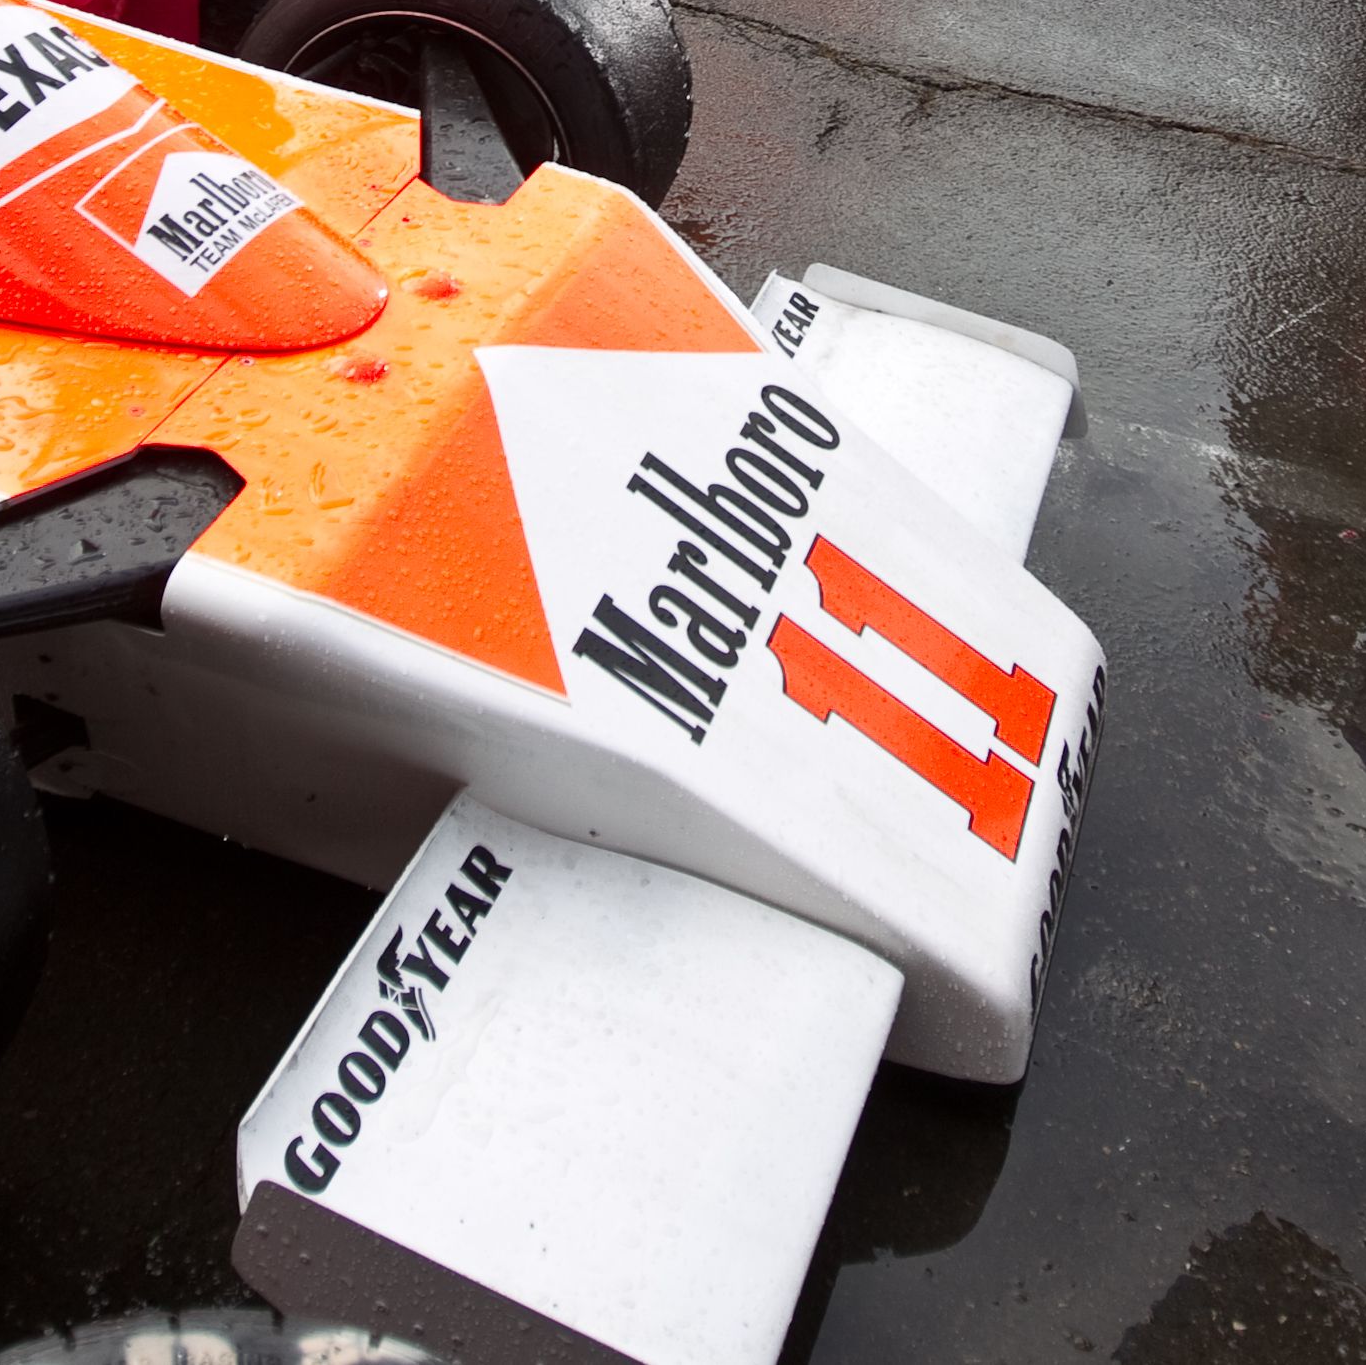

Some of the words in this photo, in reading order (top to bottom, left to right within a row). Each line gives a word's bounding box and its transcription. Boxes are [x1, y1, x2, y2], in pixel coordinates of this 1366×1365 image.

[190, 228, 244, 273] TEAM
[572, 384, 841, 746] Marlboro
[766, 532, 1058, 863] 11
[283, 844, 514, 1196] GOODYEAR
